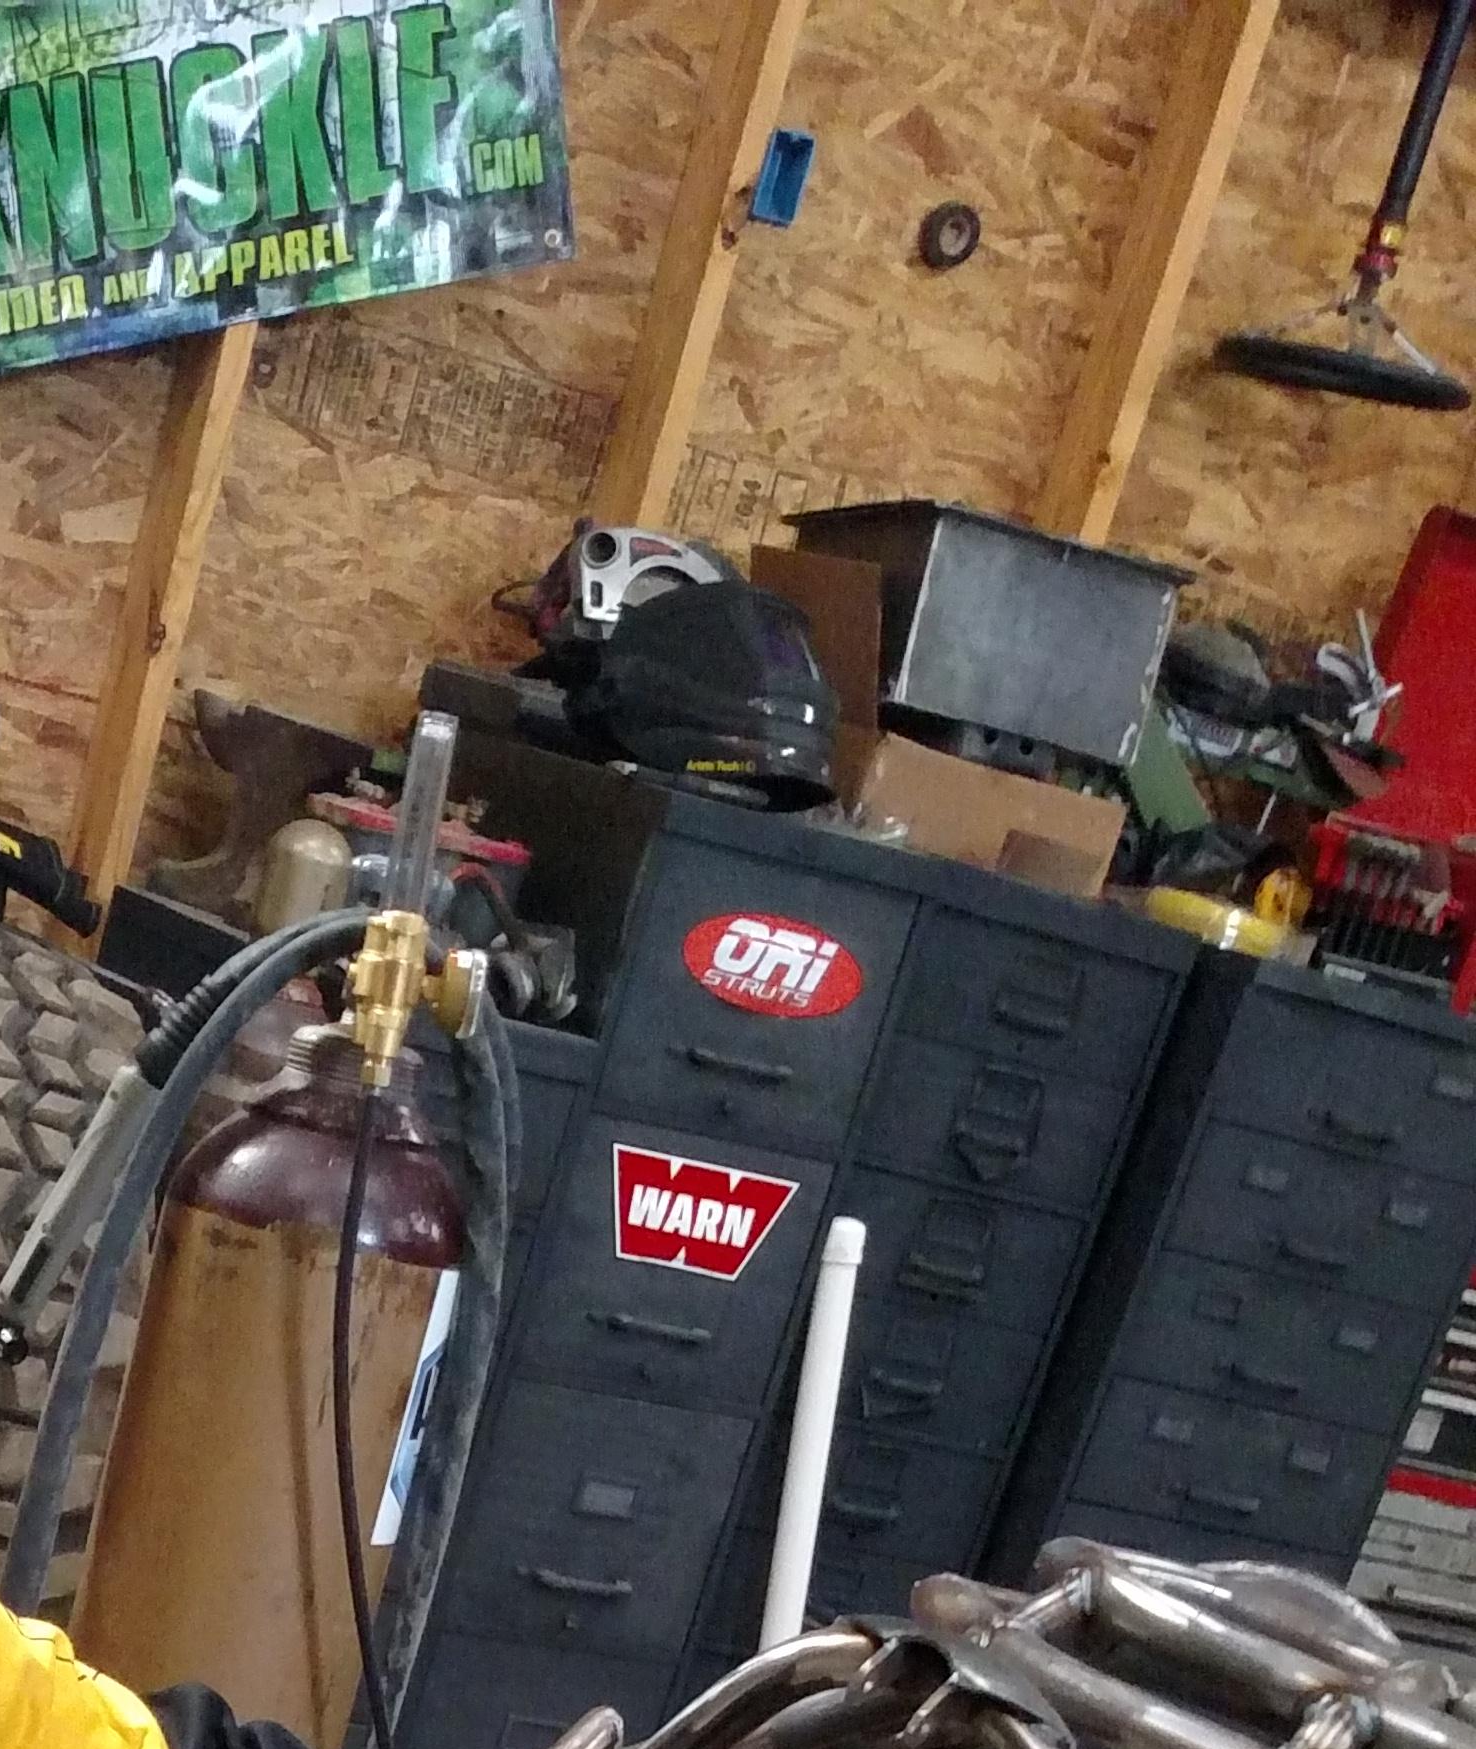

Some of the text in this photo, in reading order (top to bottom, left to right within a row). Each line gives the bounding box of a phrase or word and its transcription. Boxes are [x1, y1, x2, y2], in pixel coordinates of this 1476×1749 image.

[174, 223, 355, 299] APPAREL
[700, 967, 812, 1009] STRUTS
[627, 1183, 757, 1249] WARN
